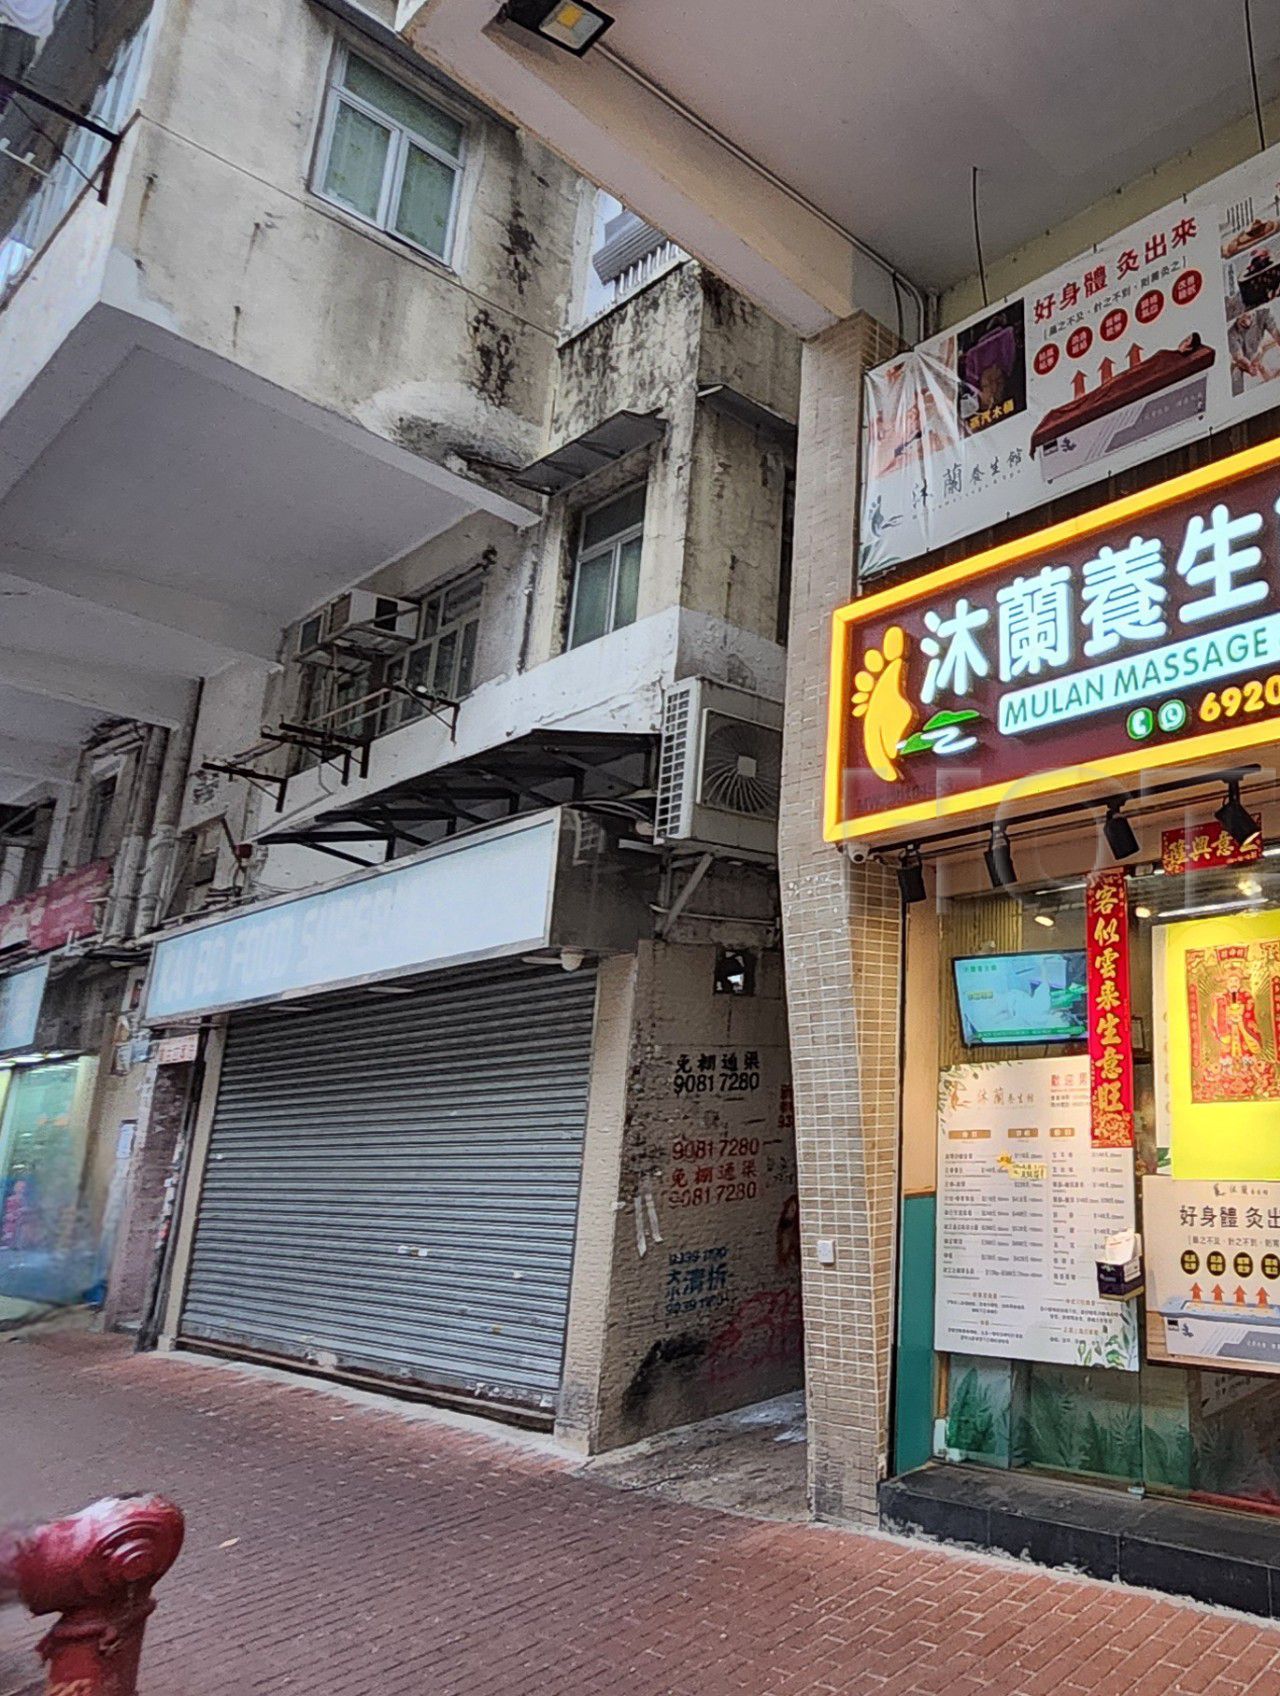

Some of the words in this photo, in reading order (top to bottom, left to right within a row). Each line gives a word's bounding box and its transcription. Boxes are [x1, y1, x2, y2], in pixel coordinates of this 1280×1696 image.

[1033, 264, 1107, 324] 好身體
[1117, 217, 1197, 280] 灸出來
[1004, 678, 1104, 730] MULAN
[1113, 635, 1270, 693] MASSAGE
[1179, 1205, 1239, 1228] 好身體
